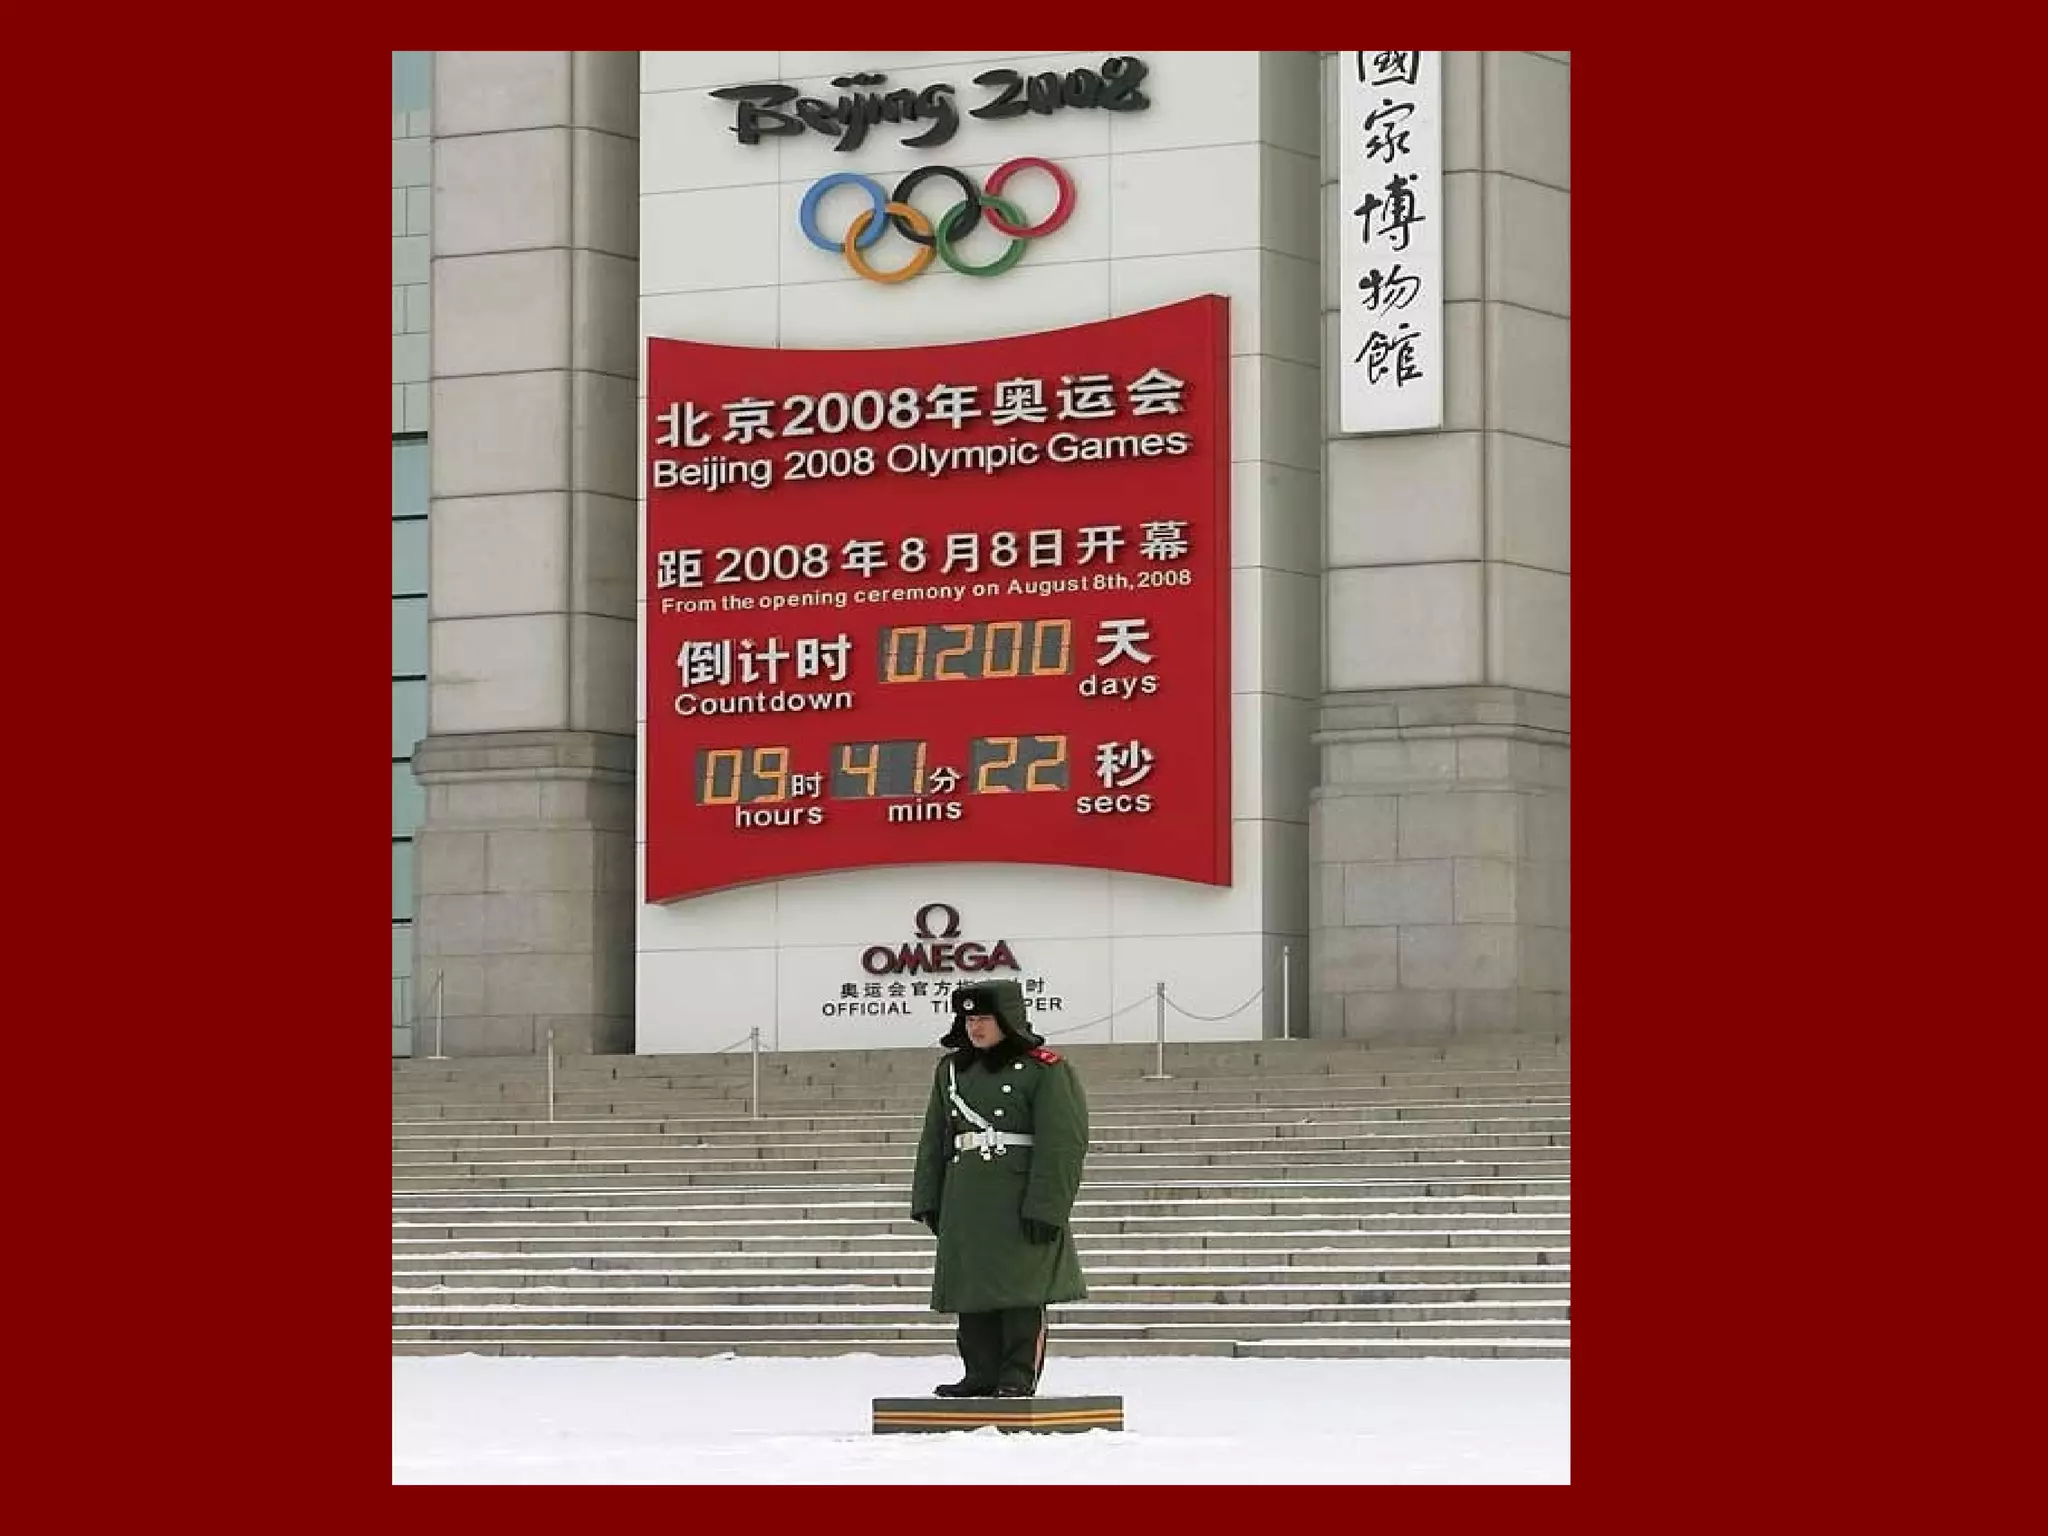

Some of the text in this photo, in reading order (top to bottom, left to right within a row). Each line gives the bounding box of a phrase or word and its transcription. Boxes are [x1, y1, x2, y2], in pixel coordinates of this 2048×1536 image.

[708, 55, 1152, 151] Beijing 2008
[654, 432, 1188, 492] Beijing 2008 Olympic Games
[661, 598, 716, 614] From
[722, 595, 755, 611] the
[759, 589, 848, 611] opening
[854, 583, 966, 602] ceremony
[972, 582, 999, 597] on
[1007, 574, 1088, 597] August
[677, 618, 1154, 688] 倒计时 0200 天
[675, 674, 1159, 716] Countdown days
[704, 735, 1154, 803] 09 时 41 分 22 秒
[735, 793, 1152, 828] hours mins secs
[862, 940, 1022, 976] OMEGA
[822, 1001, 912, 1016] OFFICIAL
